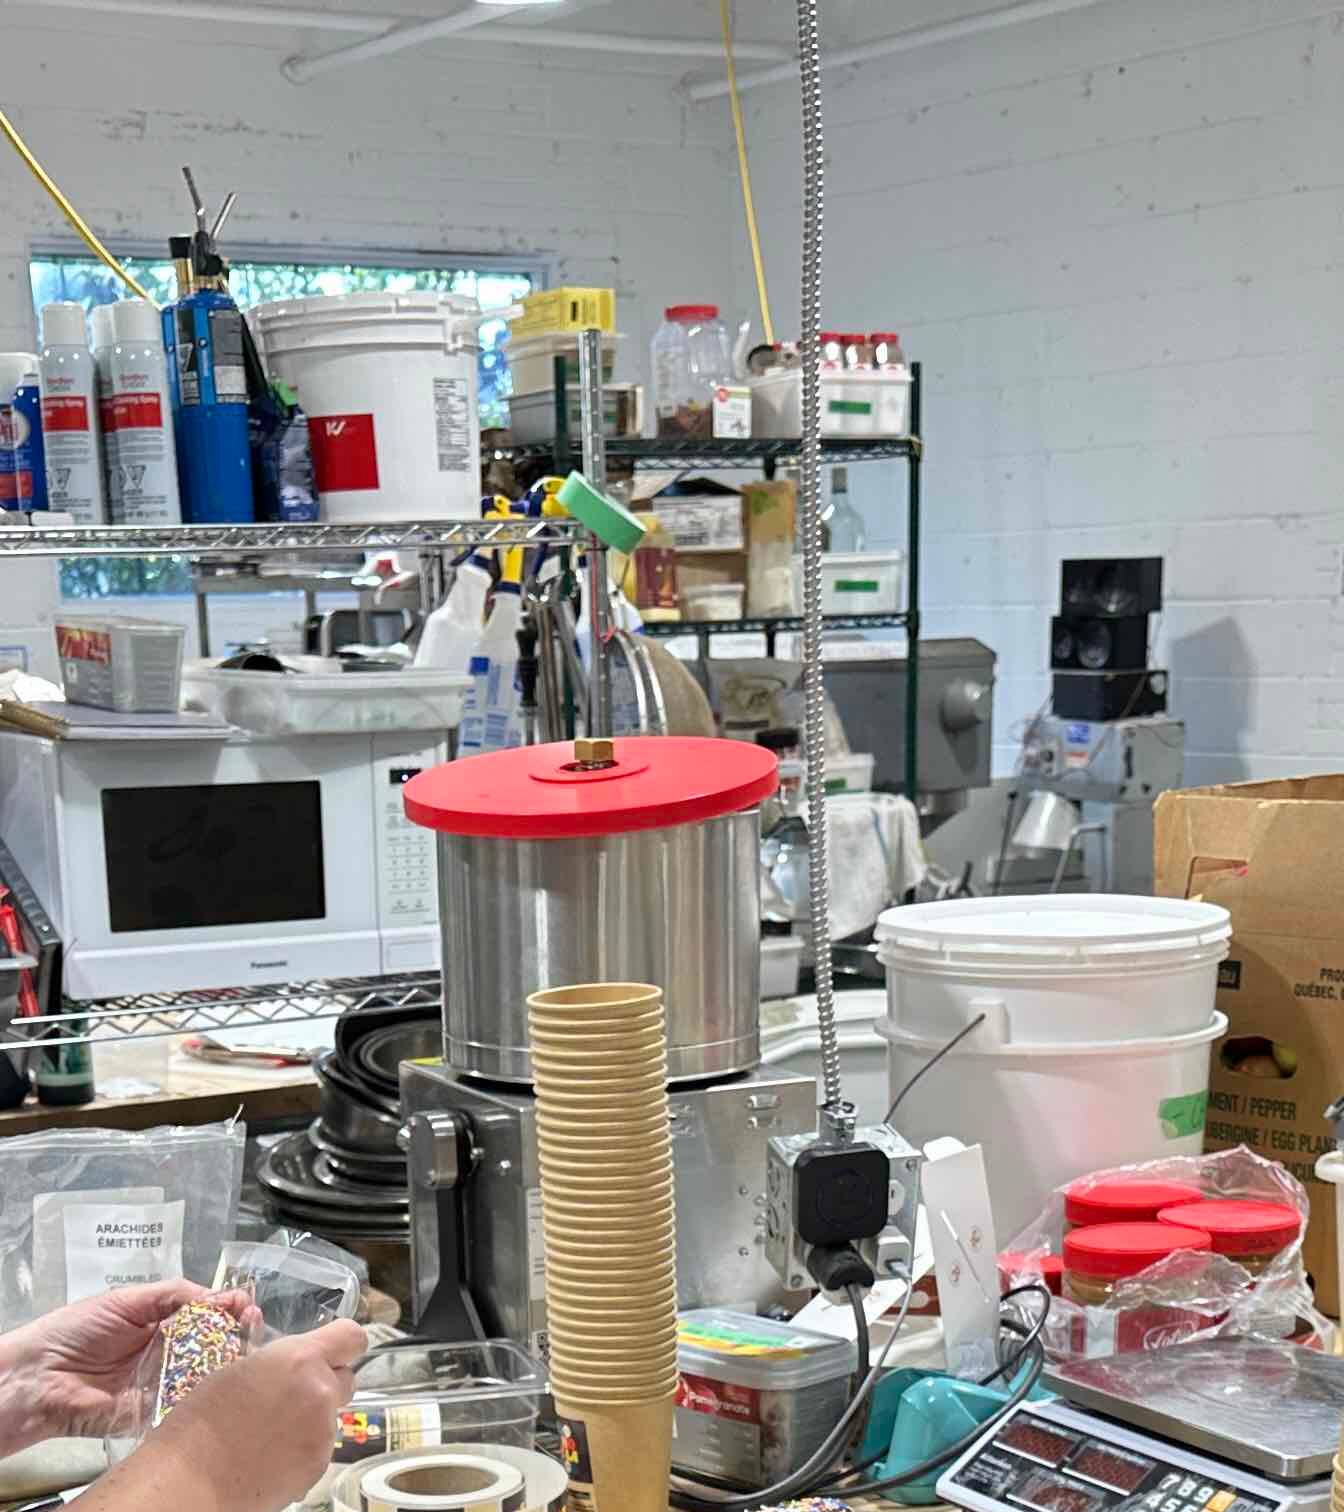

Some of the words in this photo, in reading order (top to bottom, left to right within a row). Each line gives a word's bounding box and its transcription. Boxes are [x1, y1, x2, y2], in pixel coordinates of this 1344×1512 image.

[1249, 1099, 1296, 1120] PEPPER
[1272, 1130, 1296, 1150] EGG
[96, 1222, 163, 1234] ARACHIDES
[1161, 1474, 1181, 1490] 7
[1178, 1480, 1197, 1497] 8
[1194, 1487, 1213, 1503] 9
